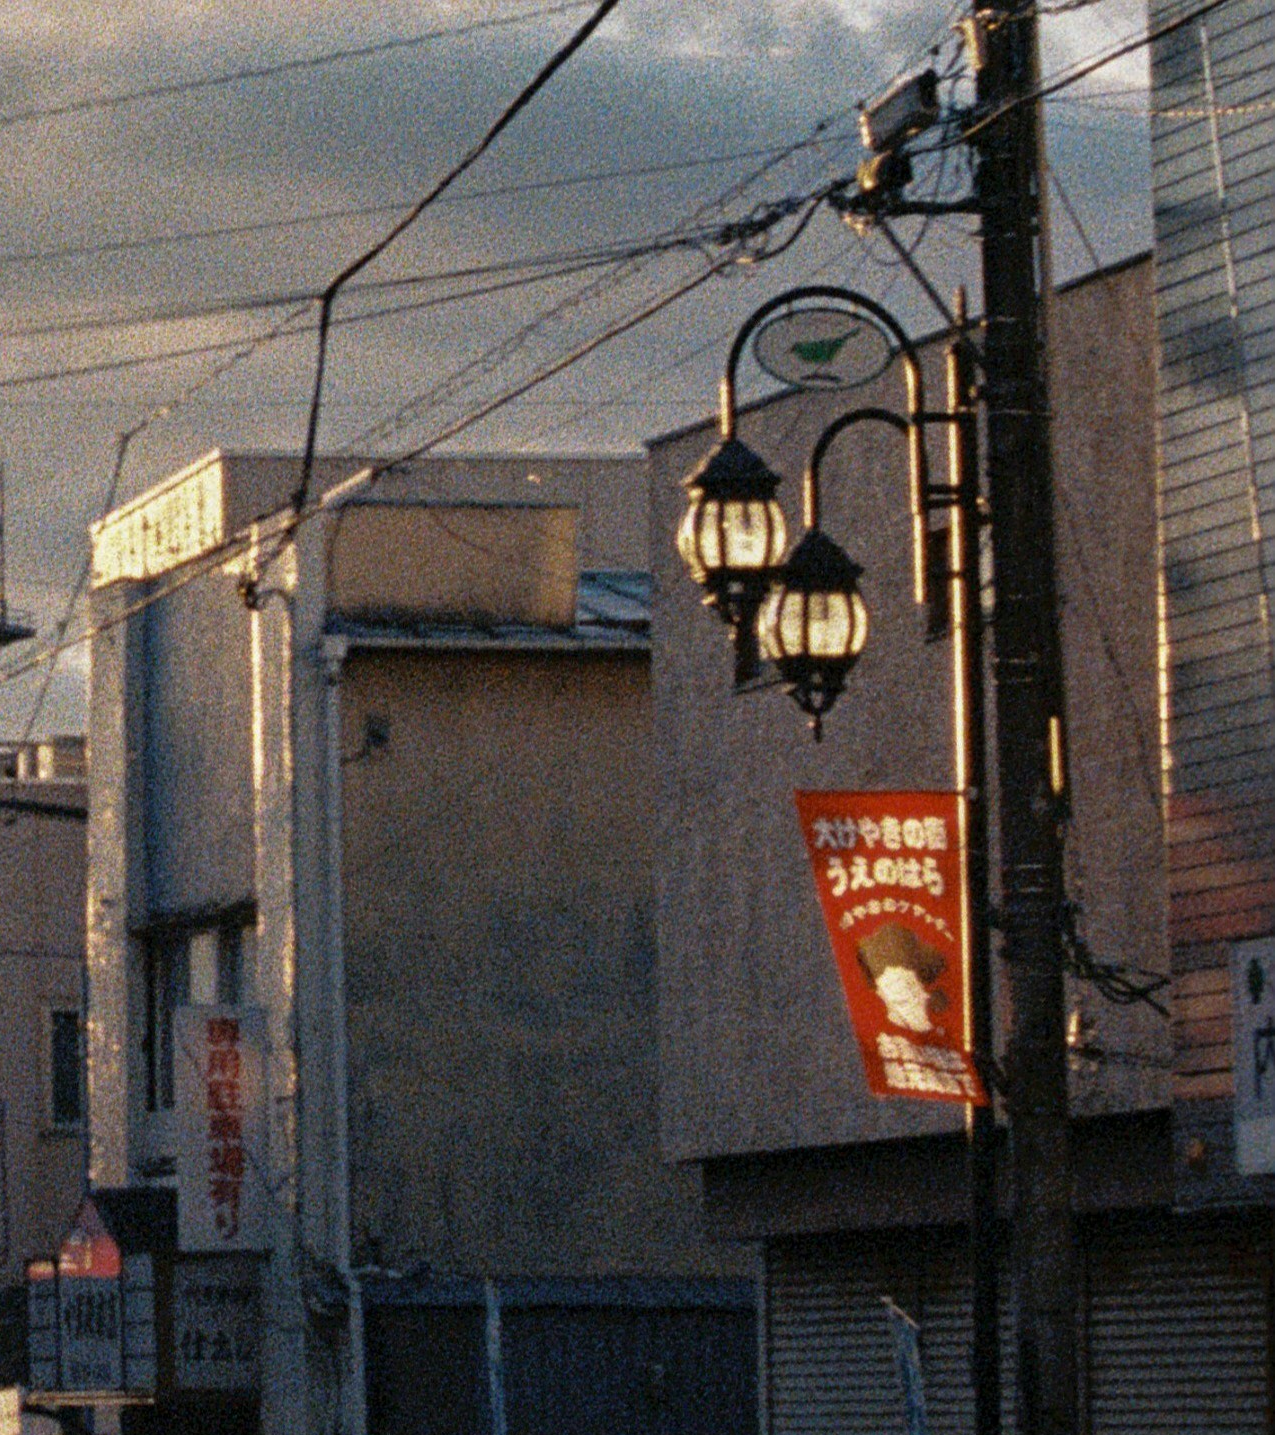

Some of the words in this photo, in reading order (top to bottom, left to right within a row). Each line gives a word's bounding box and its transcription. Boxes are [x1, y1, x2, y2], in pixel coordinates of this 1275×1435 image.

[827, 856, 945, 897] うえのはら
